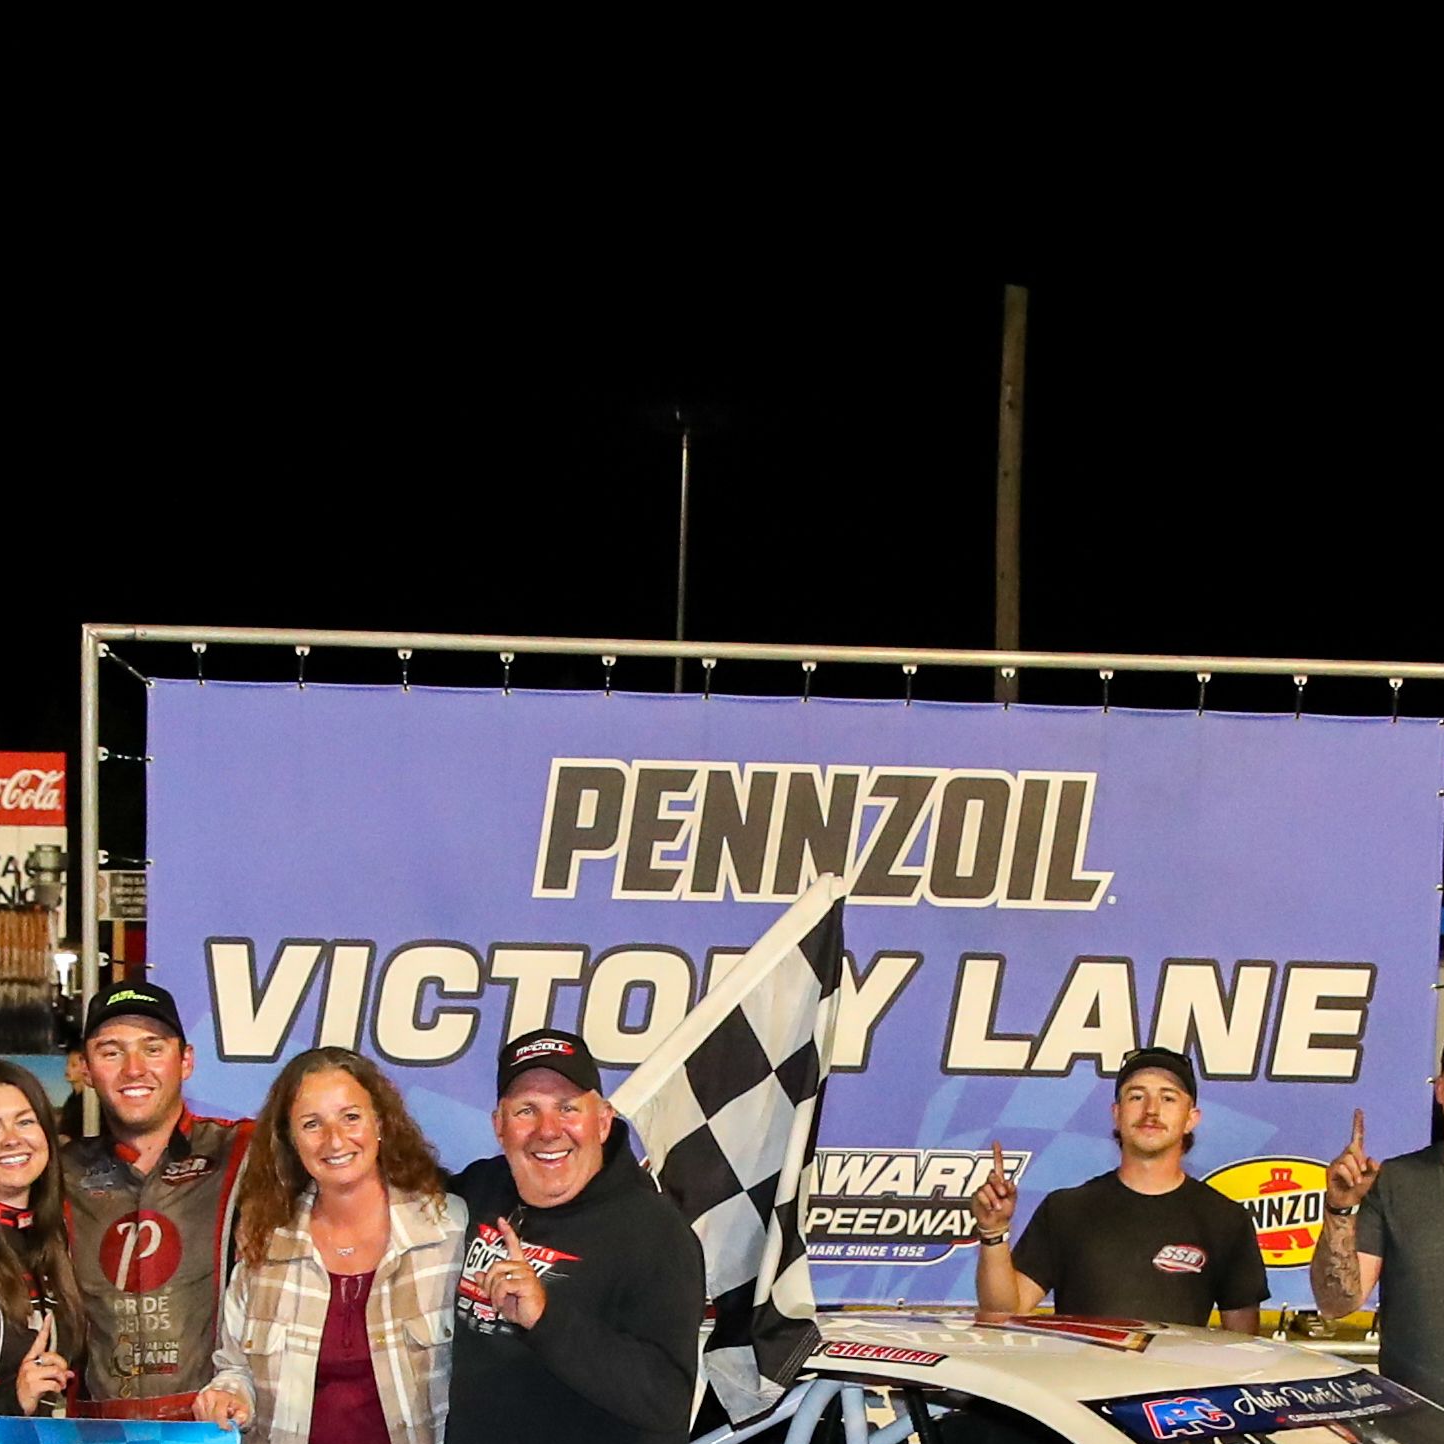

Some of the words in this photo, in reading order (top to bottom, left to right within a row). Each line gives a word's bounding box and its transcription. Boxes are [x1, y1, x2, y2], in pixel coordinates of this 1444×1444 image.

[532, 757, 1114, 910] PENNZOIL
[206, 937, 923, 1070] VICTOY
[941, 952, 1377, 1083] LANE
[165, 1158, 208, 1176] SSR
[803, 1207, 978, 1237] PEEDWAY
[845, 1245, 887, 1258] SINCE
[891, 1245, 926, 1258] 1952
[113, 1295, 170, 1315] PRDE
[827, 1341, 941, 1365] SHERIDAN
[1234, 1388, 1291, 1415] Auto
